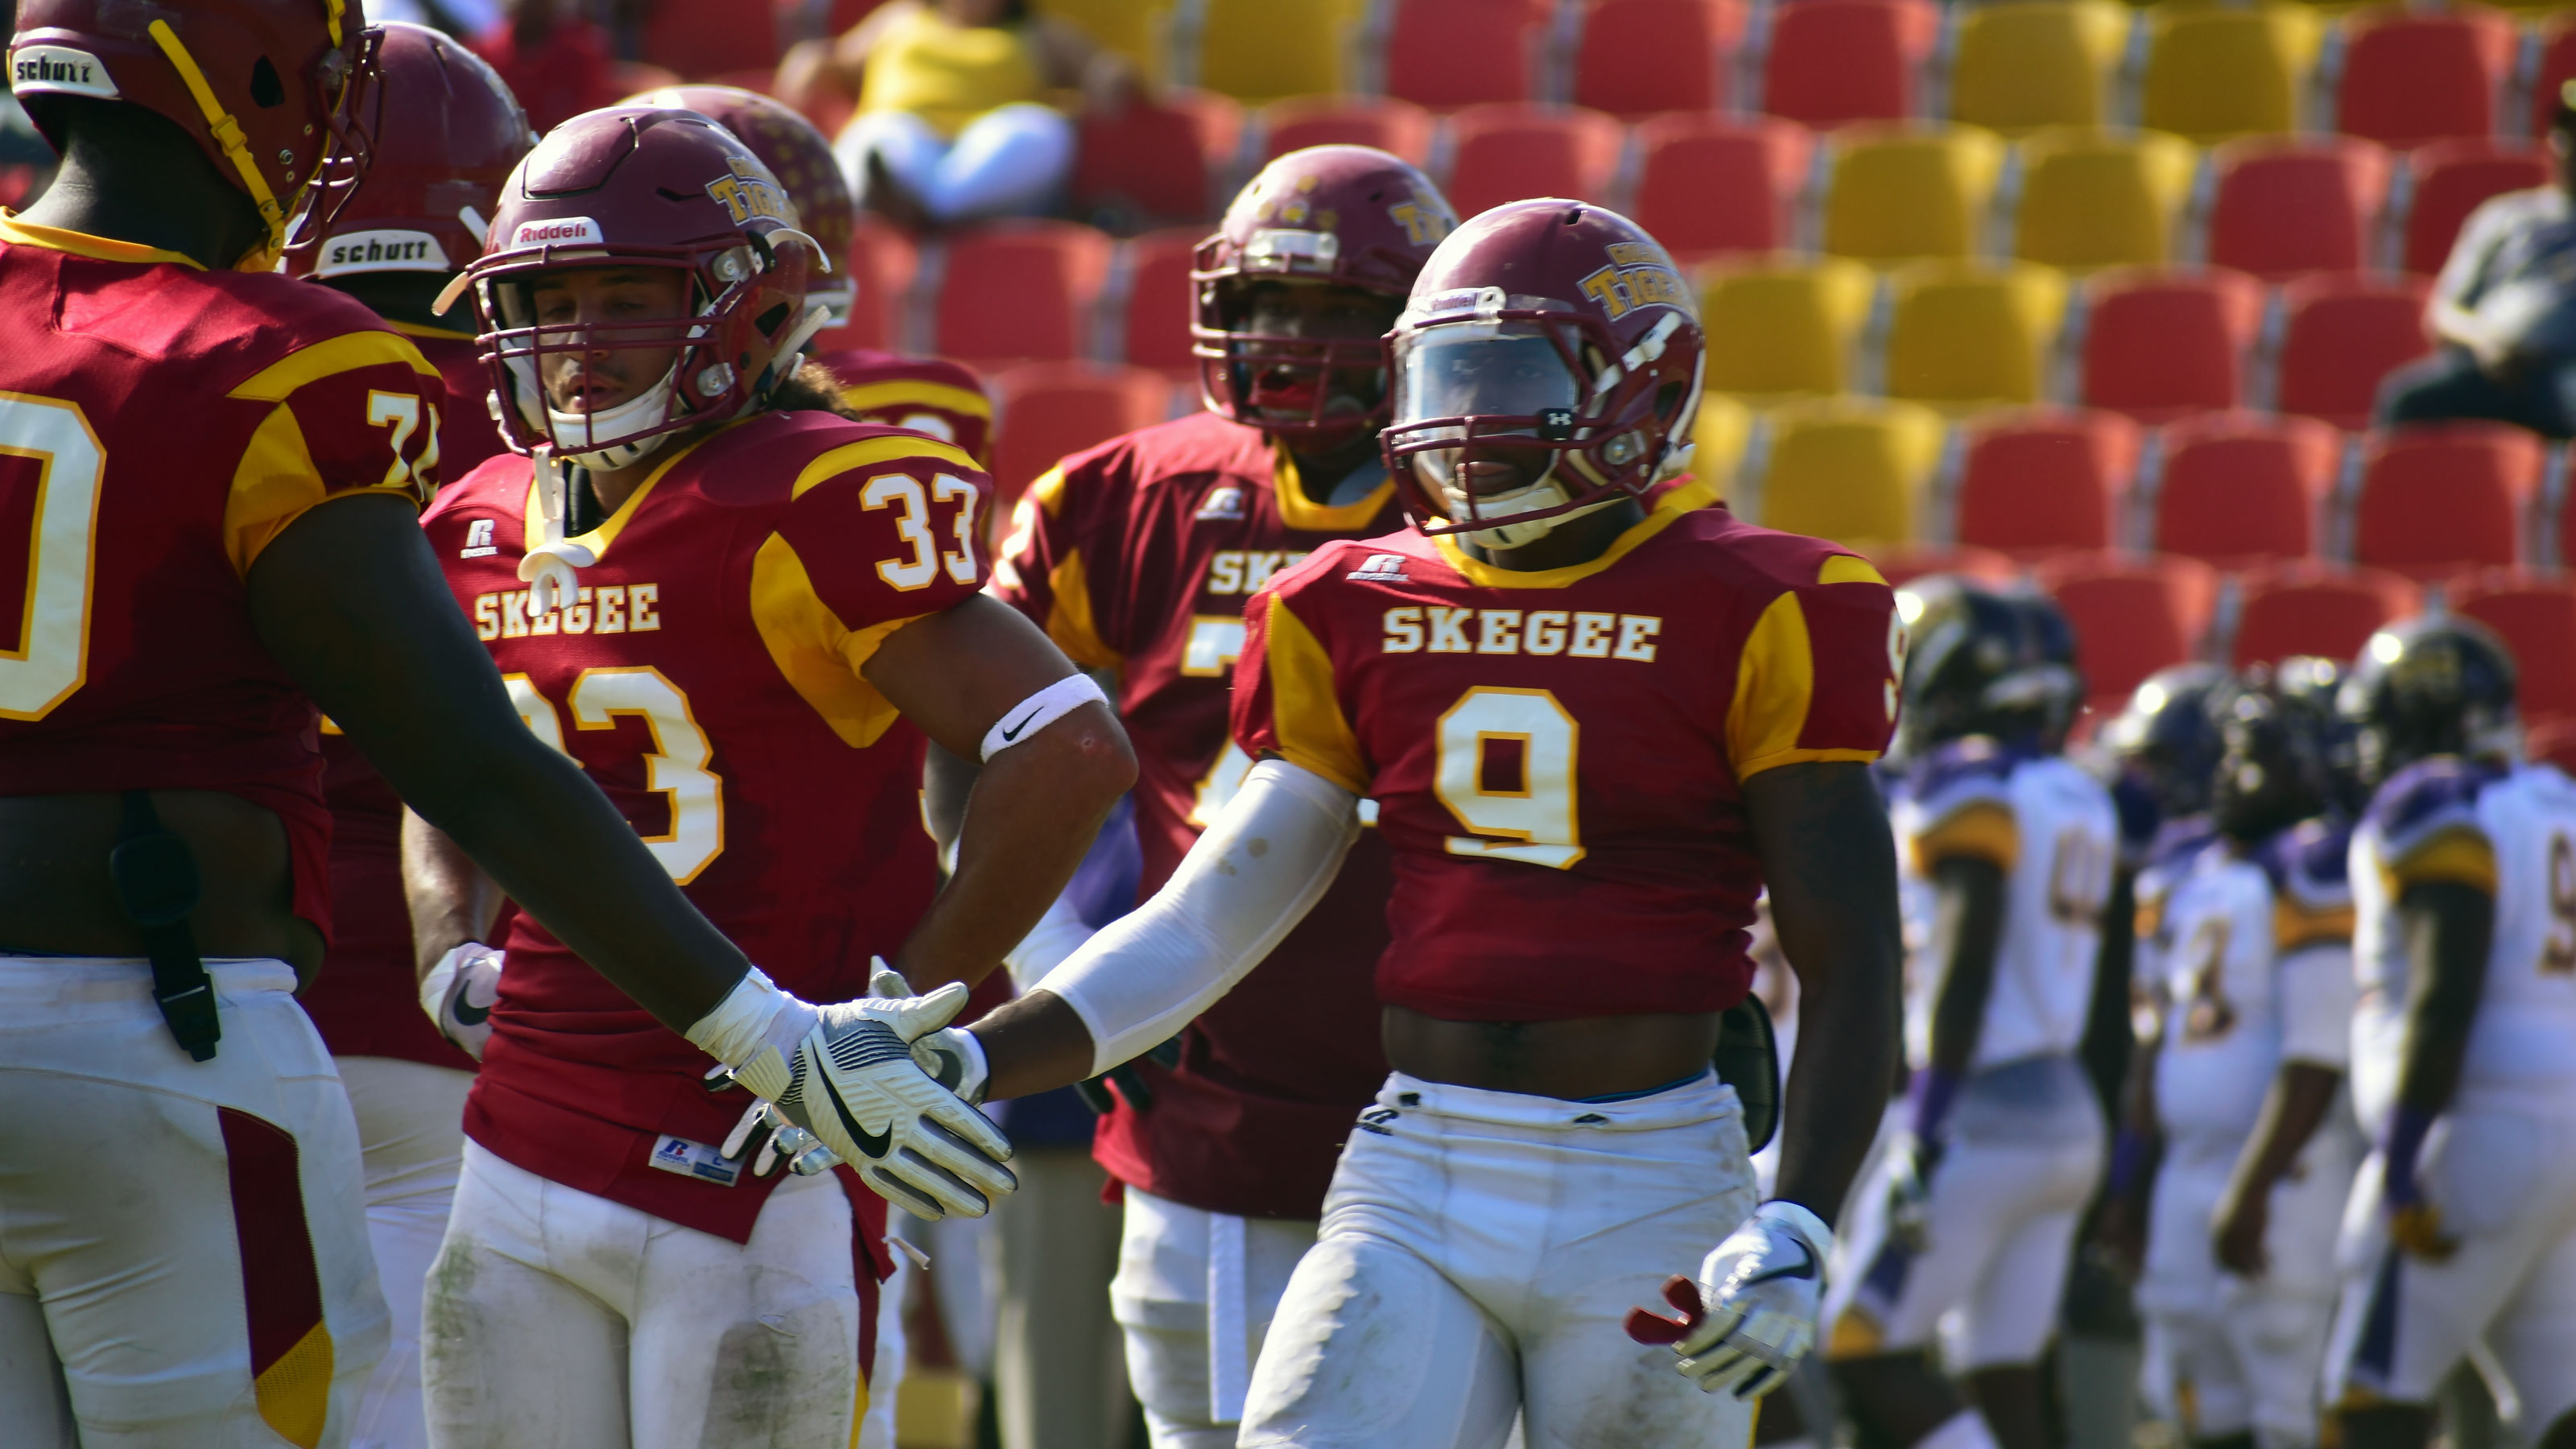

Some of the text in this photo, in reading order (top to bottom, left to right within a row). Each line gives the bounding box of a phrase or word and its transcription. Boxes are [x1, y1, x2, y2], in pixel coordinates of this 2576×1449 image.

[16, 53, 93, 83] schutt
[332, 238, 428, 264] schutt
[859, 473, 978, 592] 33
[1208, 550, 1311, 596] SK
[1381, 606, 1663, 663] SKEGEE
[1434, 686, 1587, 870] 9
